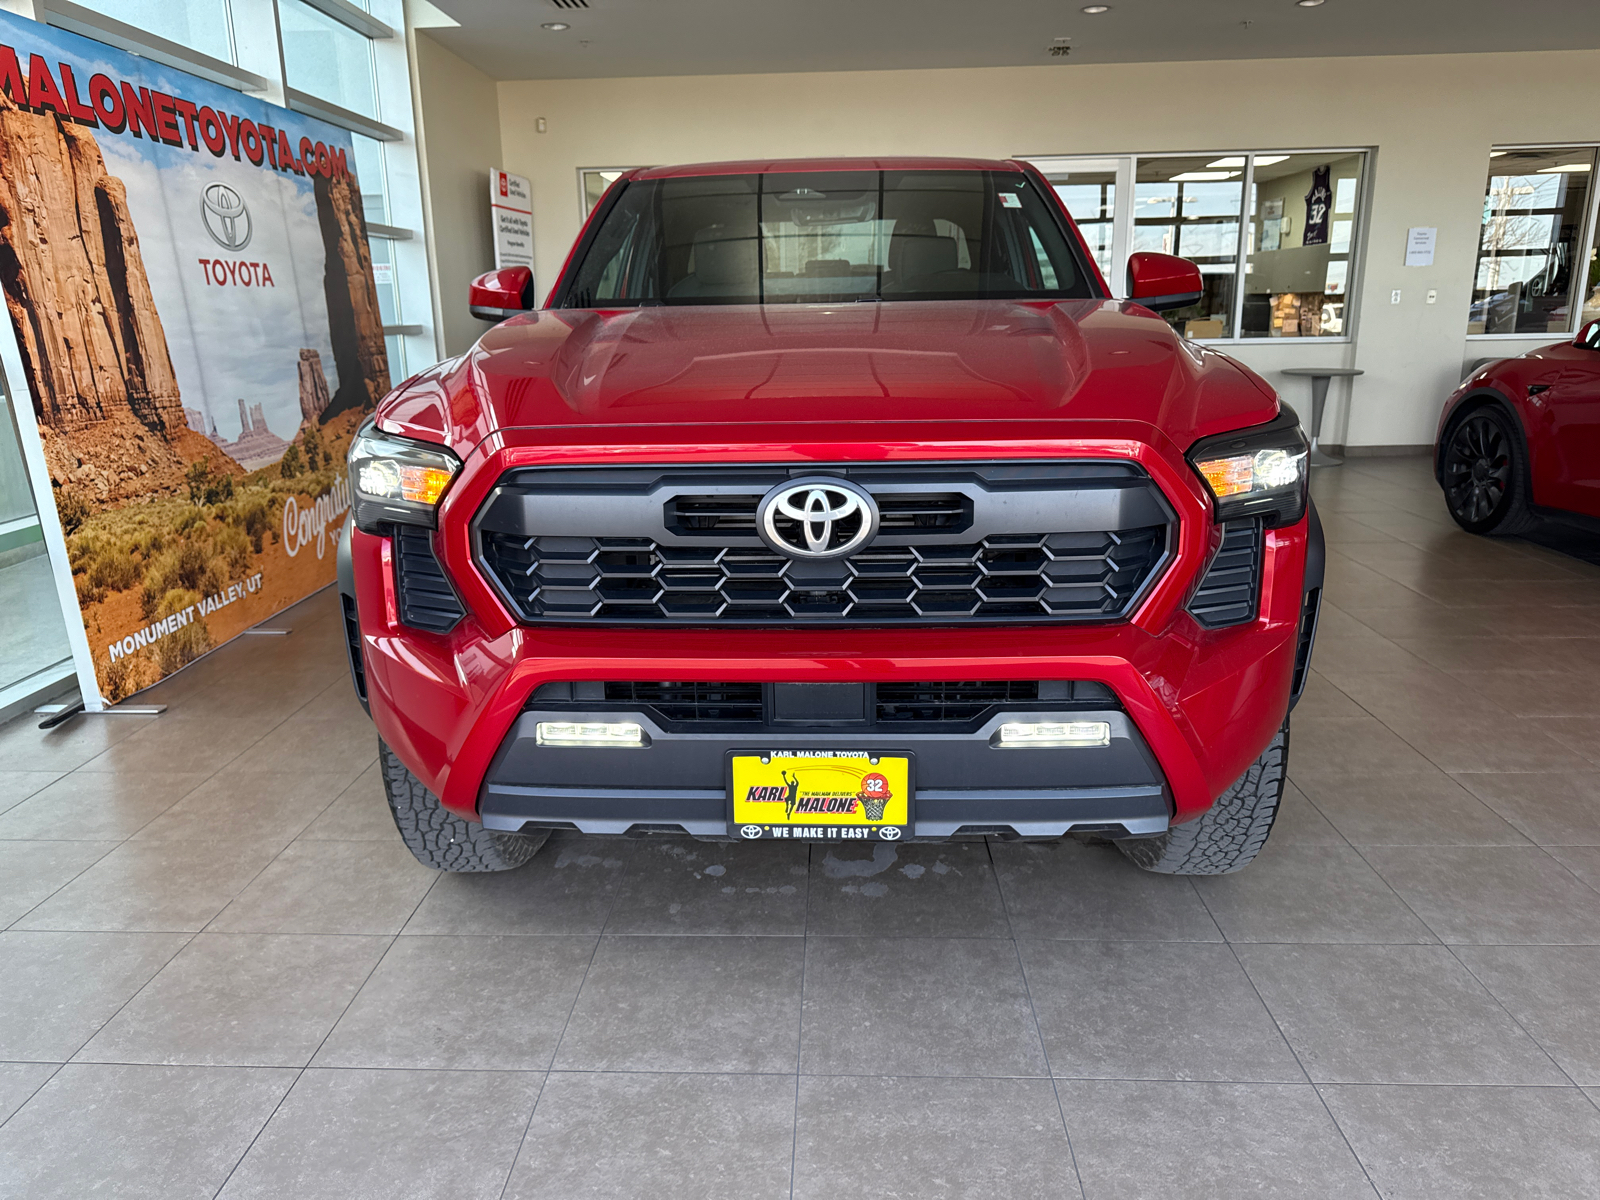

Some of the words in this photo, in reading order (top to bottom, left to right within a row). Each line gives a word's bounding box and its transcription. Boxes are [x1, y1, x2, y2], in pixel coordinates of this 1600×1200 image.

[1308, 203, 1326, 225] 32
[198, 258, 275, 288] TOYOTA
[108, 605, 195, 663] MONUMENT
[196, 581, 247, 618] VALLEY,
[246, 573, 262, 593] UT
[770, 750, 795, 758] KARL
[796, 750, 834, 758] MALONE
[835, 751, 869, 759] TOYOTA
[866, 778, 883, 792] 32
[745, 786, 788, 803] KARL
[795, 797, 859, 814] MALONE
[772, 827, 789, 838] WE
[793, 827, 824, 838] MAKE
[827, 827, 838, 838] IT
[841, 828, 869, 838] EASY
